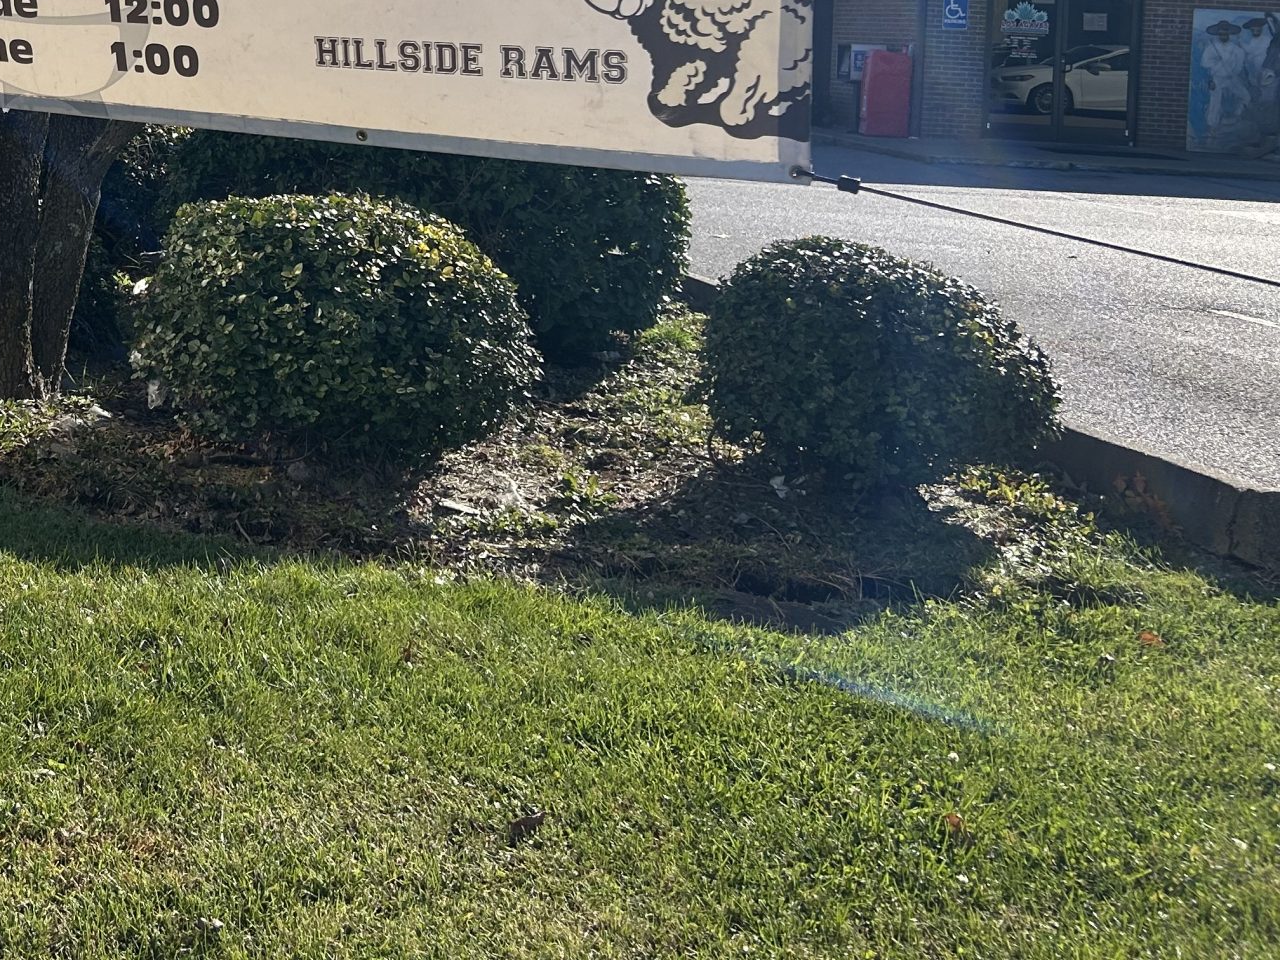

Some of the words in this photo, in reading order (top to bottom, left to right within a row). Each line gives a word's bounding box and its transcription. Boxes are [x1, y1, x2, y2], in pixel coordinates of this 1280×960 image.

[110, 41, 200, 78] 1:00
[314, 36, 483, 77] HILLSIDE
[500, 44, 628, 84] RAMS
